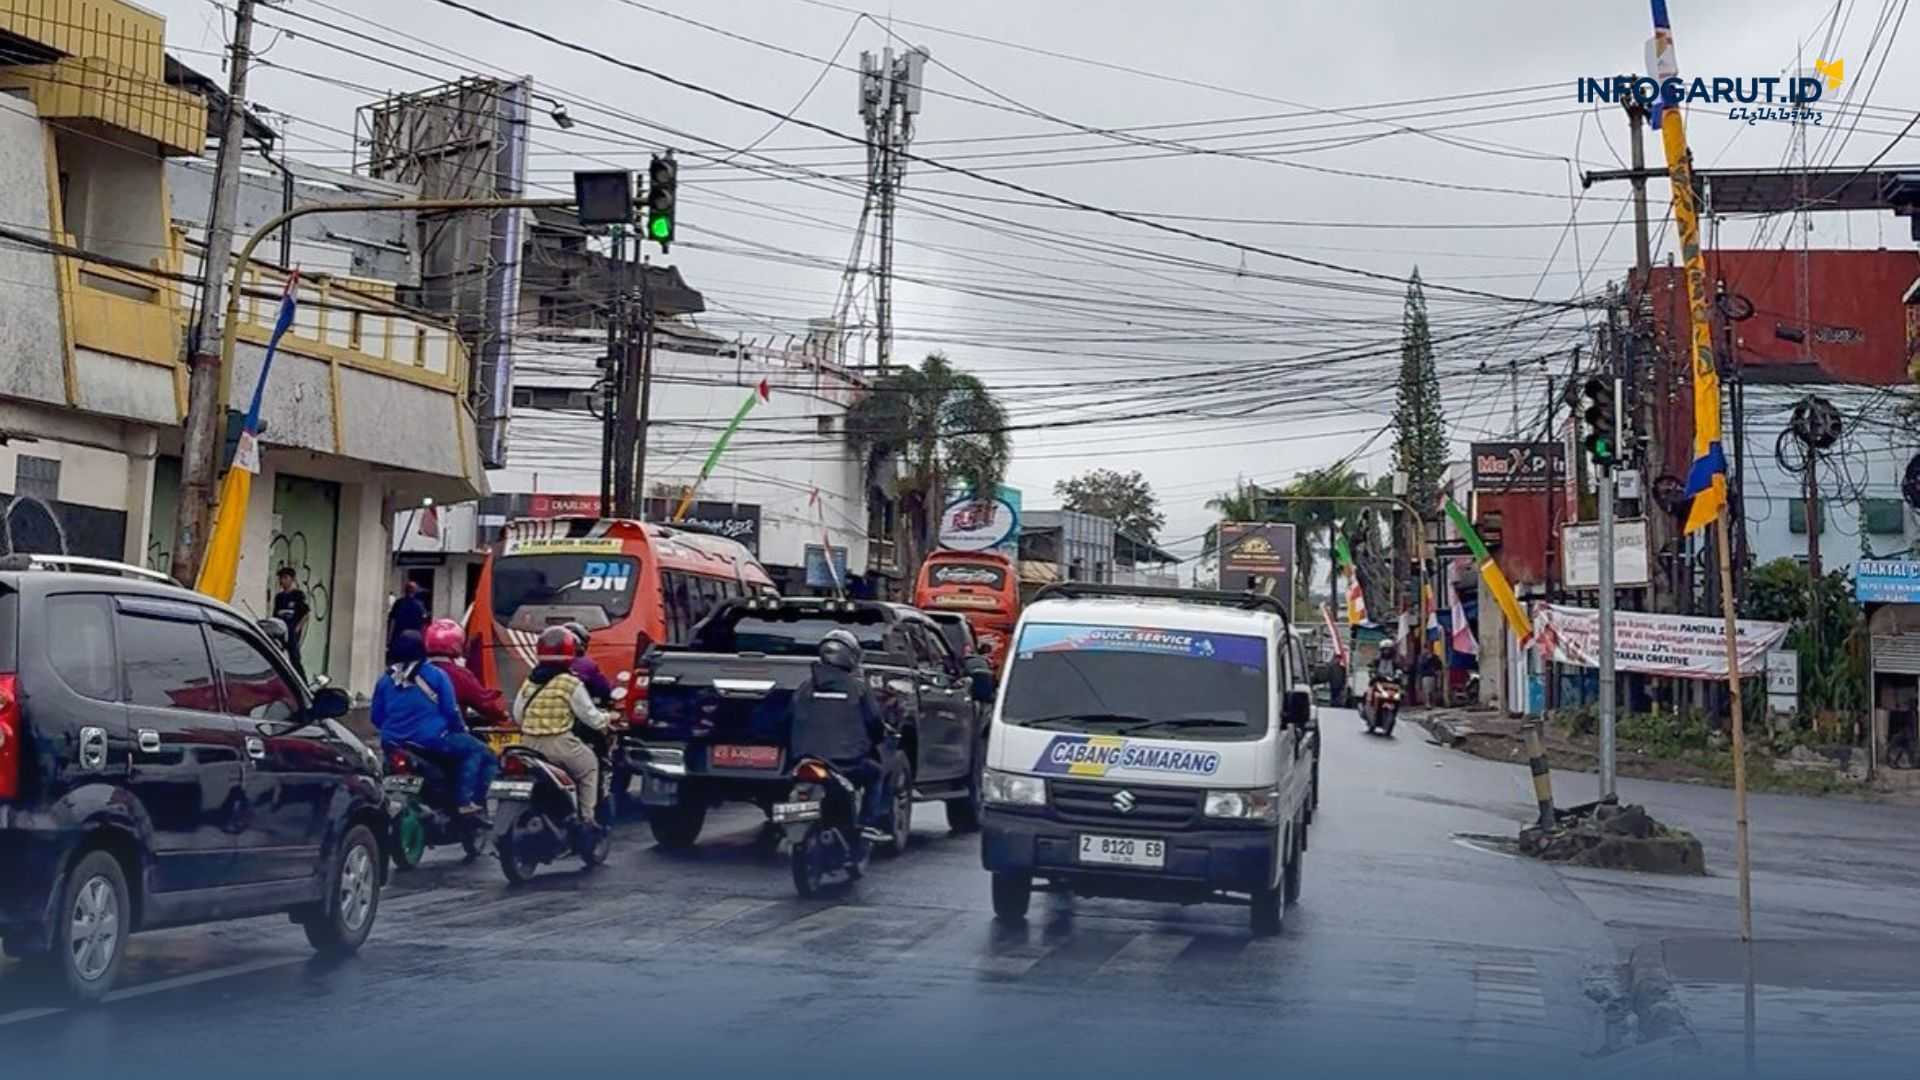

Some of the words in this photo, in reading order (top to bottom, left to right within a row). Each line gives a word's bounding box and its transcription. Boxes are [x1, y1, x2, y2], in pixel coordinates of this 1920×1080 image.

[580, 561, 631, 591] BN
[1091, 630, 1132, 641] QUICK
[1136, 632, 1193, 645] SERVICE
[1680, 623, 1716, 635] PANITIA
[1646, 653, 1689, 667] CREATIVE
[1053, 742, 1121, 764] CABANG
[1123, 748, 1217, 773] SAMARANG
[1083, 837, 1091, 853] Z
[1102, 838, 1135, 856] 8120
[1145, 842, 1162, 858] EB
